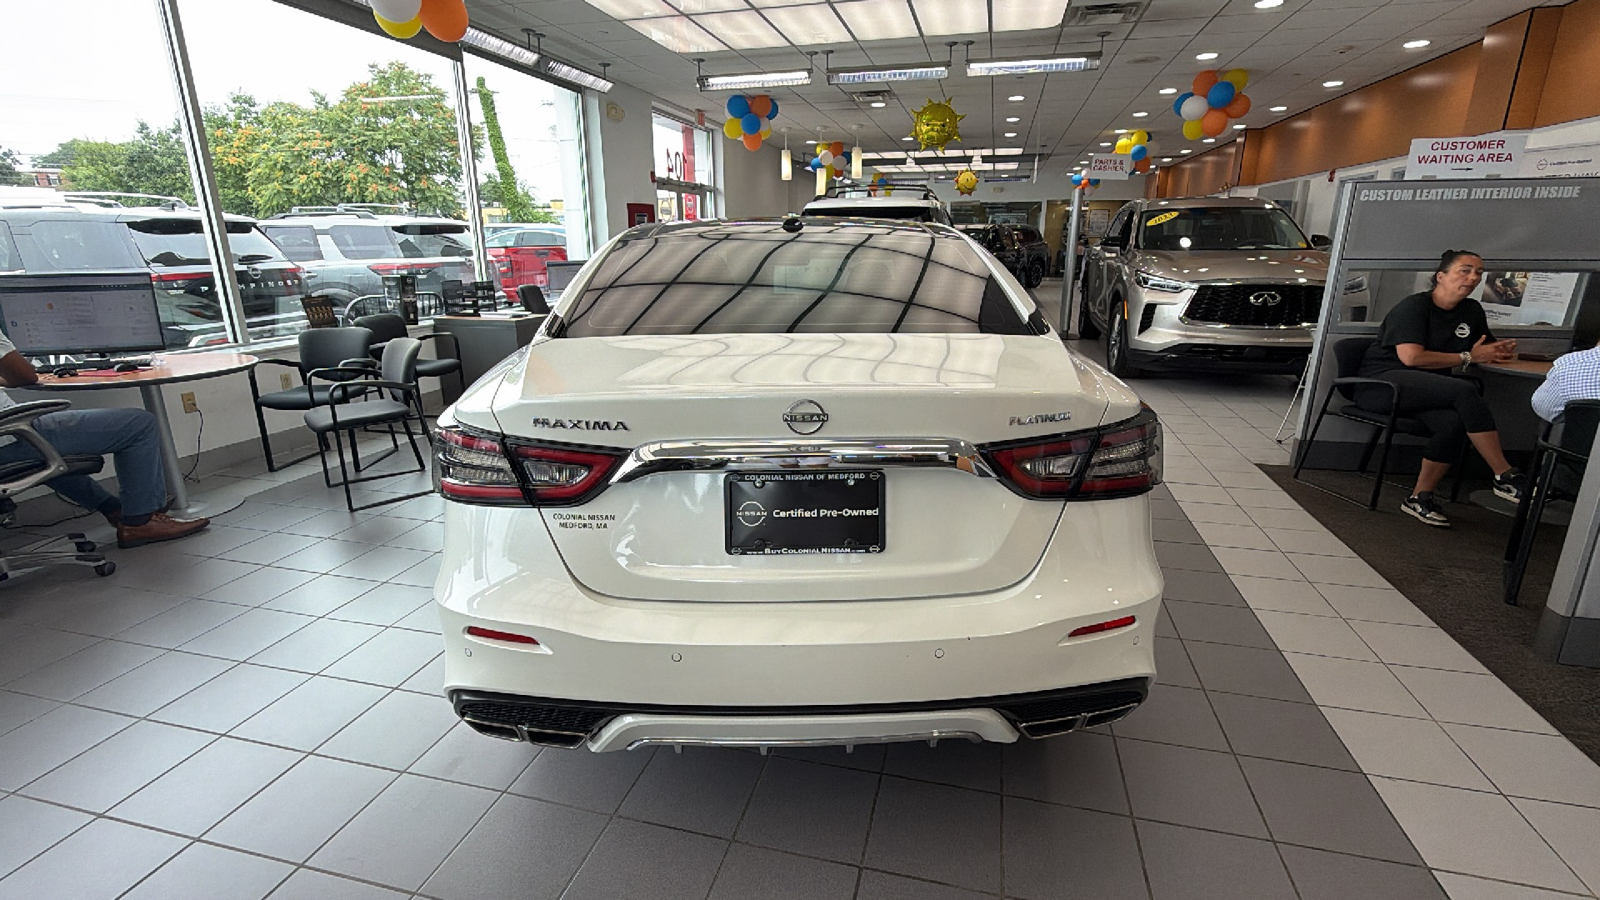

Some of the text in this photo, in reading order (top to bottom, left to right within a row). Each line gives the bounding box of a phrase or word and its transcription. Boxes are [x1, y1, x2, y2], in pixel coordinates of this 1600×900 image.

[1431, 140, 1506, 151] CUSTOMER
[1417, 153, 1513, 164] WAITING AREA
[1360, 186, 1581, 201] CUSTOM LEATHER INTERIOR INSIDE
[1009, 411, 1071, 425] PLATINUM
[532, 417, 630, 431] MAXIMA
[773, 508, 879, 517] Certified Pre-Owned
[559, 522, 594, 530] MEDFORD,
